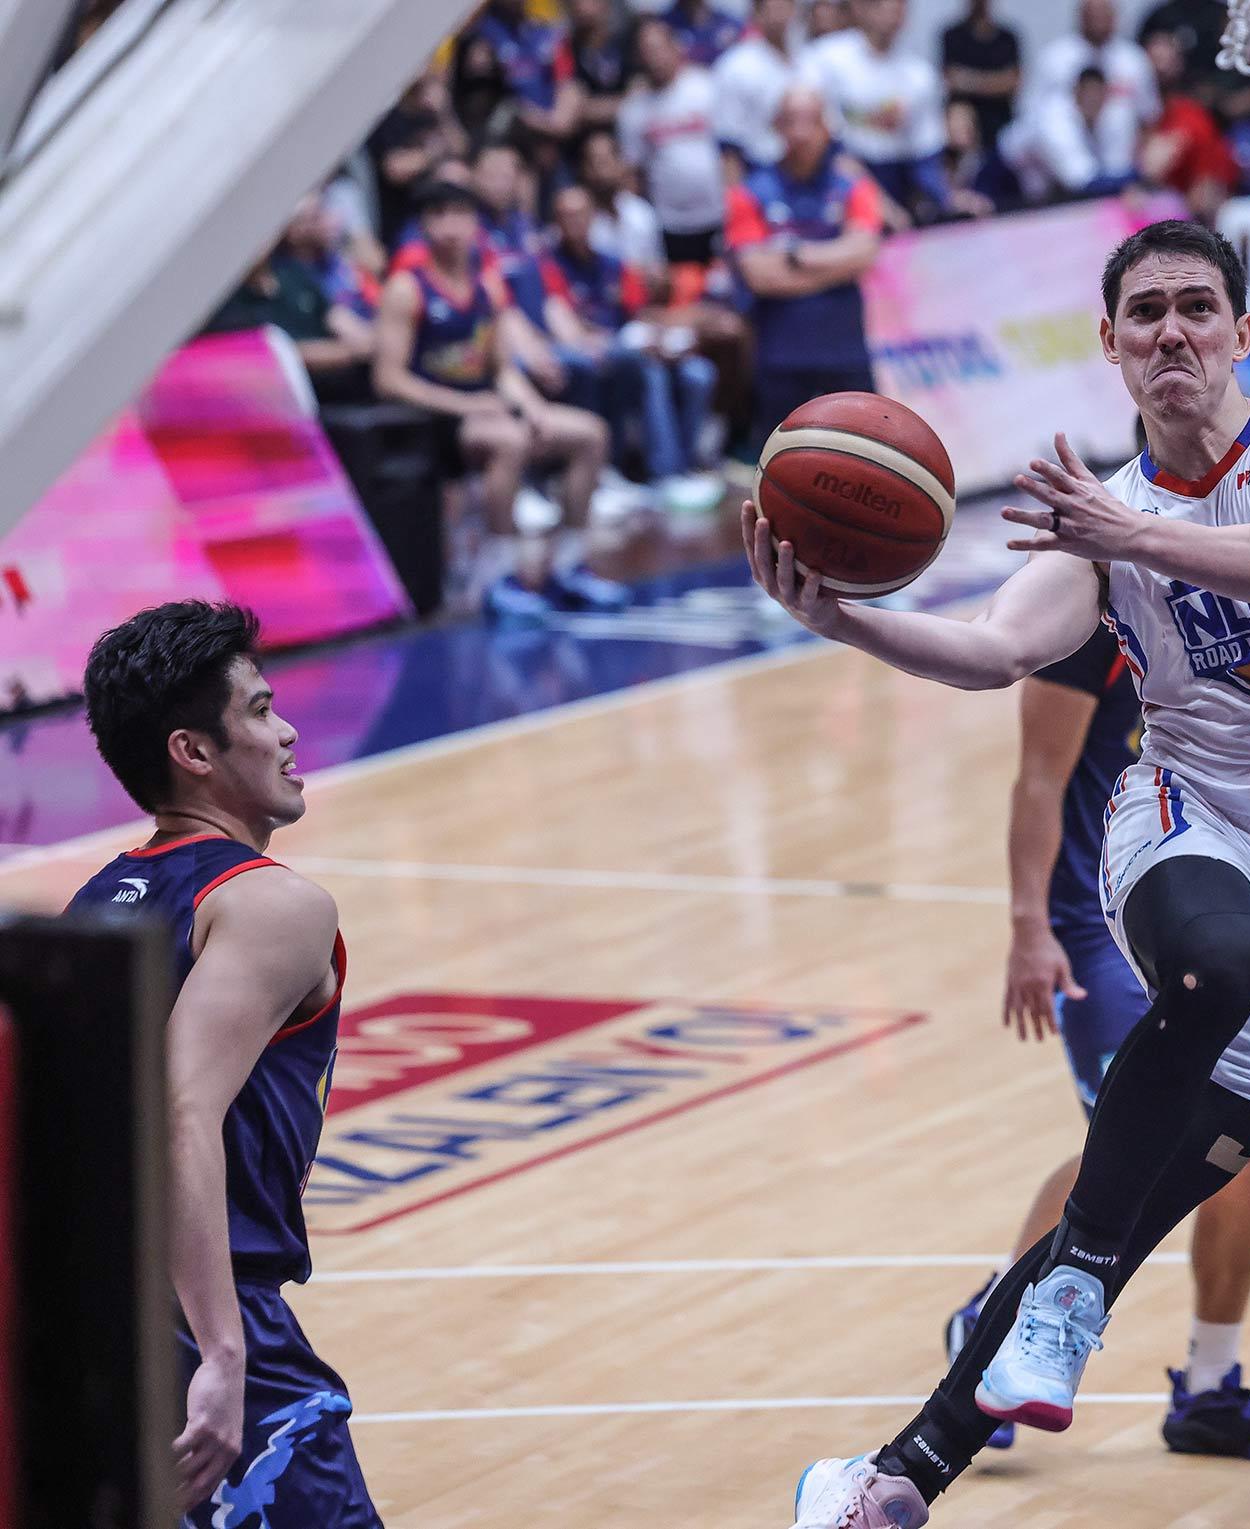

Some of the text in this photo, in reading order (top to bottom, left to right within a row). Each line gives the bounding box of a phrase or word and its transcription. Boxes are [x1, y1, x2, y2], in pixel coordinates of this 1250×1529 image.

[812, 470, 902, 519] molten
[1192, 641, 1242, 671] ROAD
[111, 889, 138, 903] ANTA
